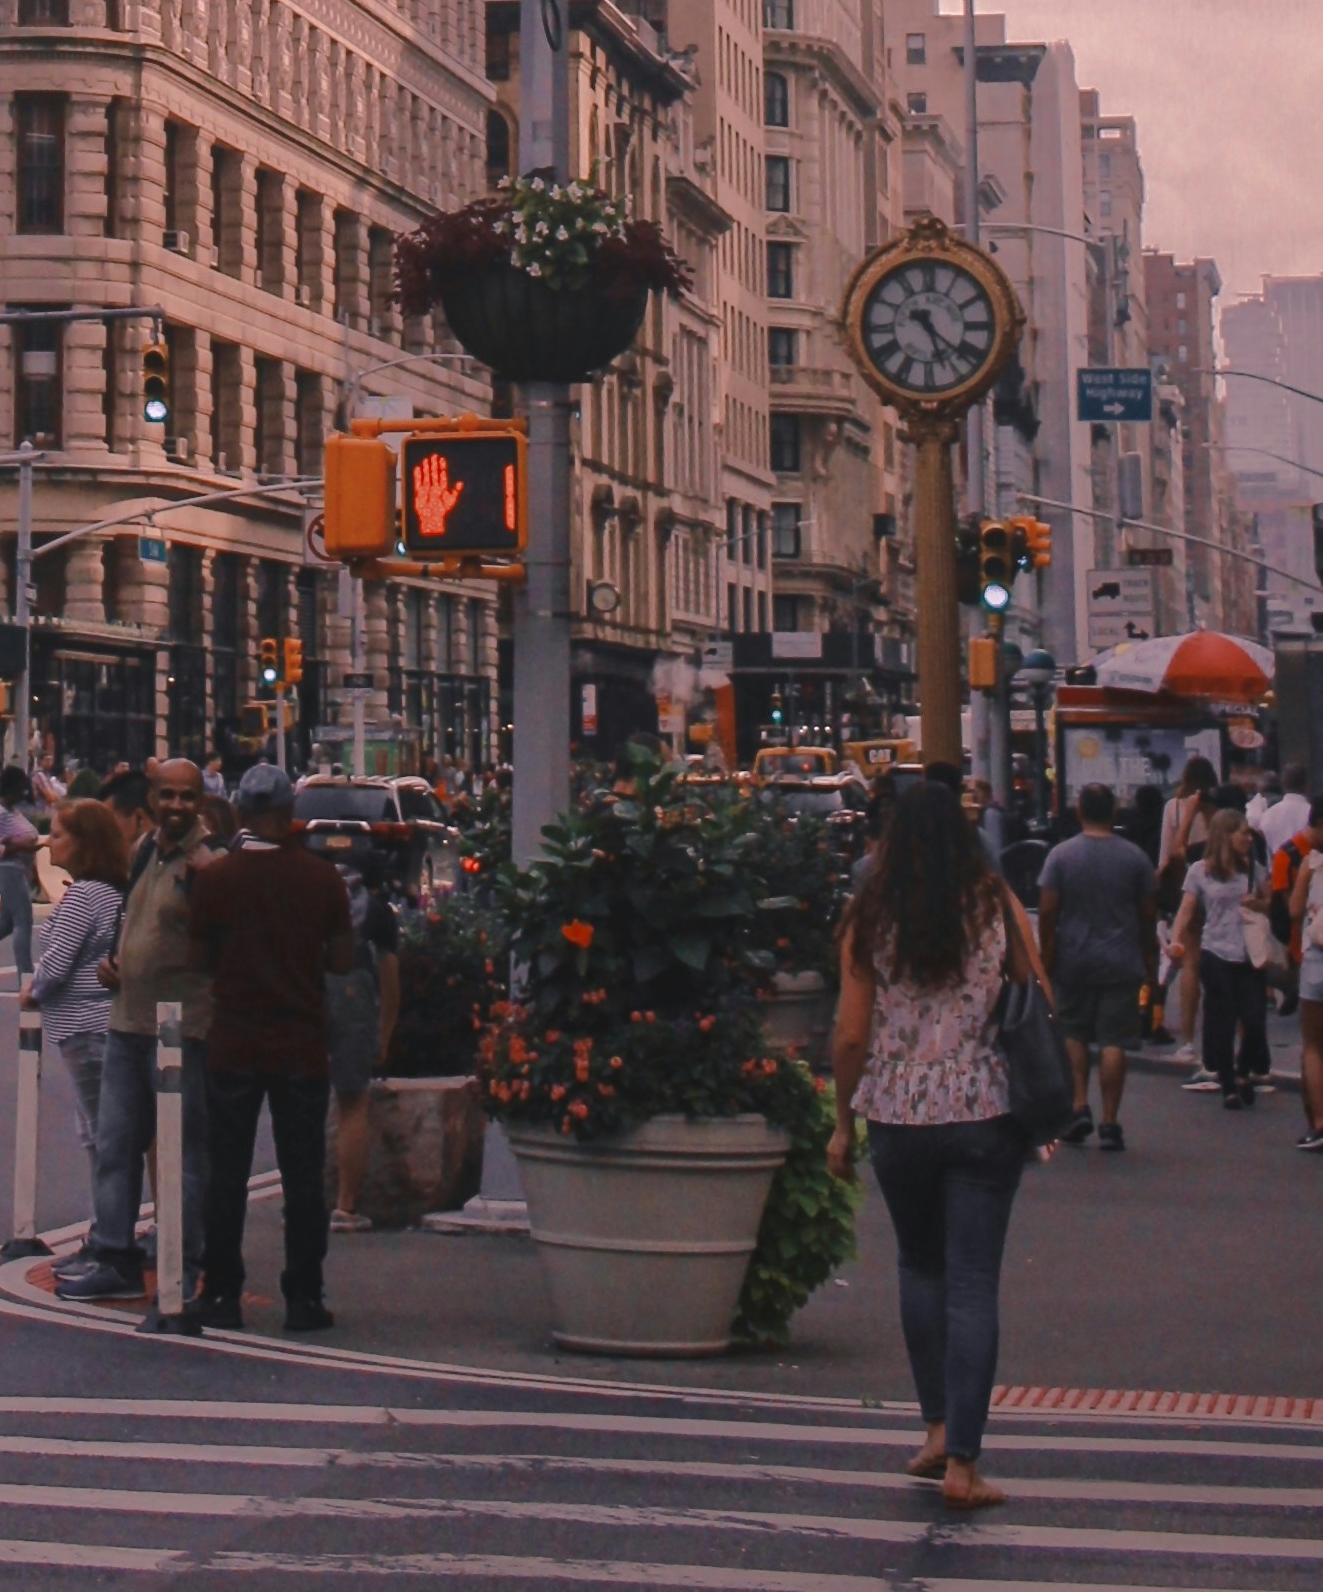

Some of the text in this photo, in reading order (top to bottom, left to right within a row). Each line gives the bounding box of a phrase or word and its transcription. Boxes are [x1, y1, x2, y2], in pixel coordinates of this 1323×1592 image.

[1081, 372, 1147, 384] West Side
[1086, 386, 1143, 401] Highway
[868, 748, 892, 763] CAT
